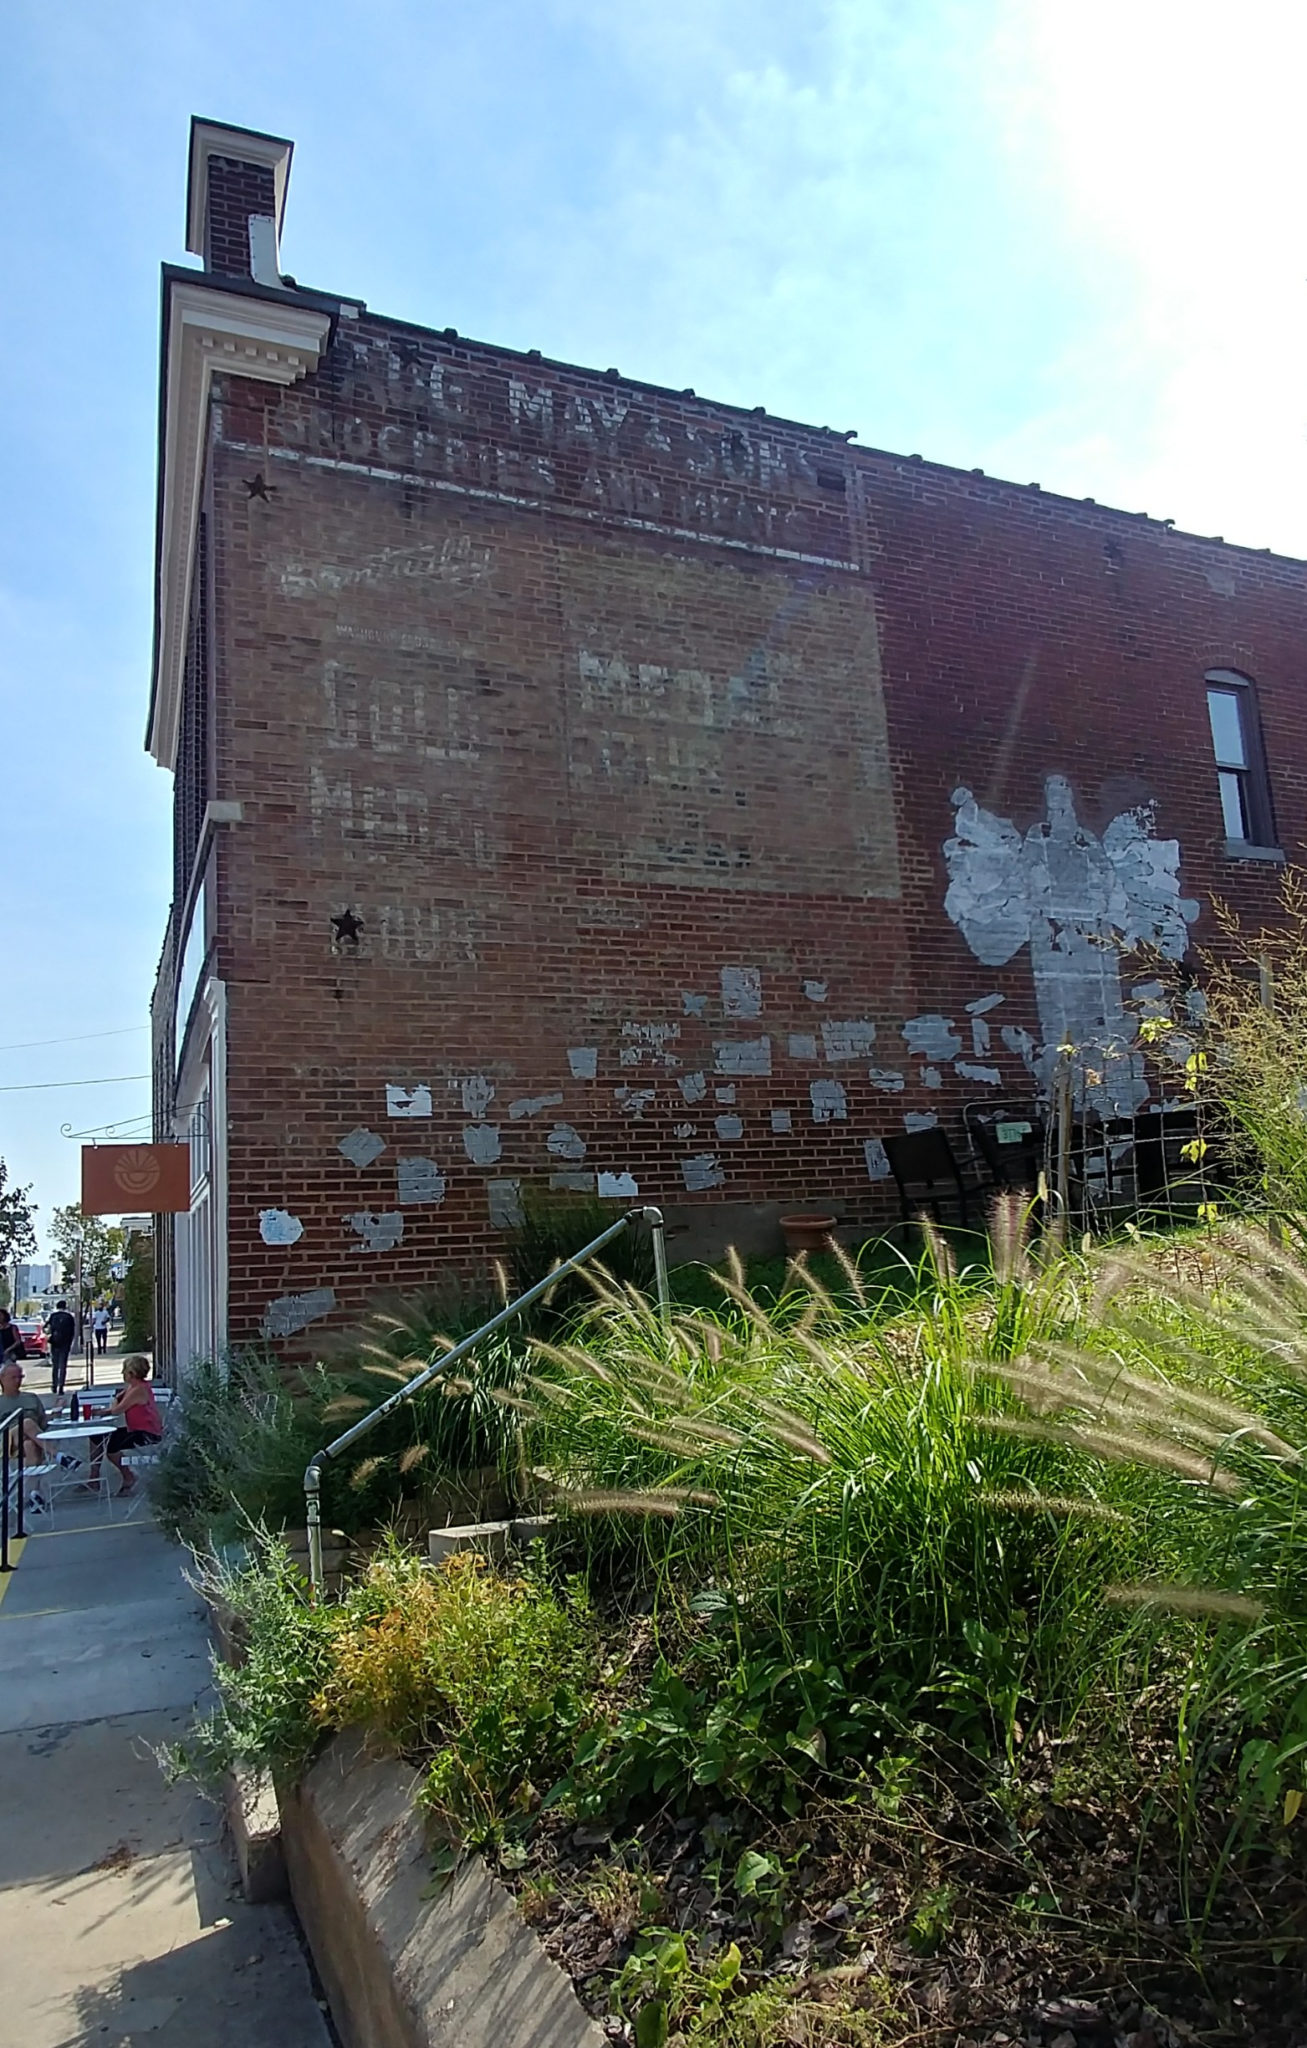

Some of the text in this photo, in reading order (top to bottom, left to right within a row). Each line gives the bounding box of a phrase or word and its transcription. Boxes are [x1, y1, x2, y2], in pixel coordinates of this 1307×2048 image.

[275, 402, 557, 490] GROCERIES
[578, 463, 662, 516] AND
[508, 380, 629, 455] MAY
